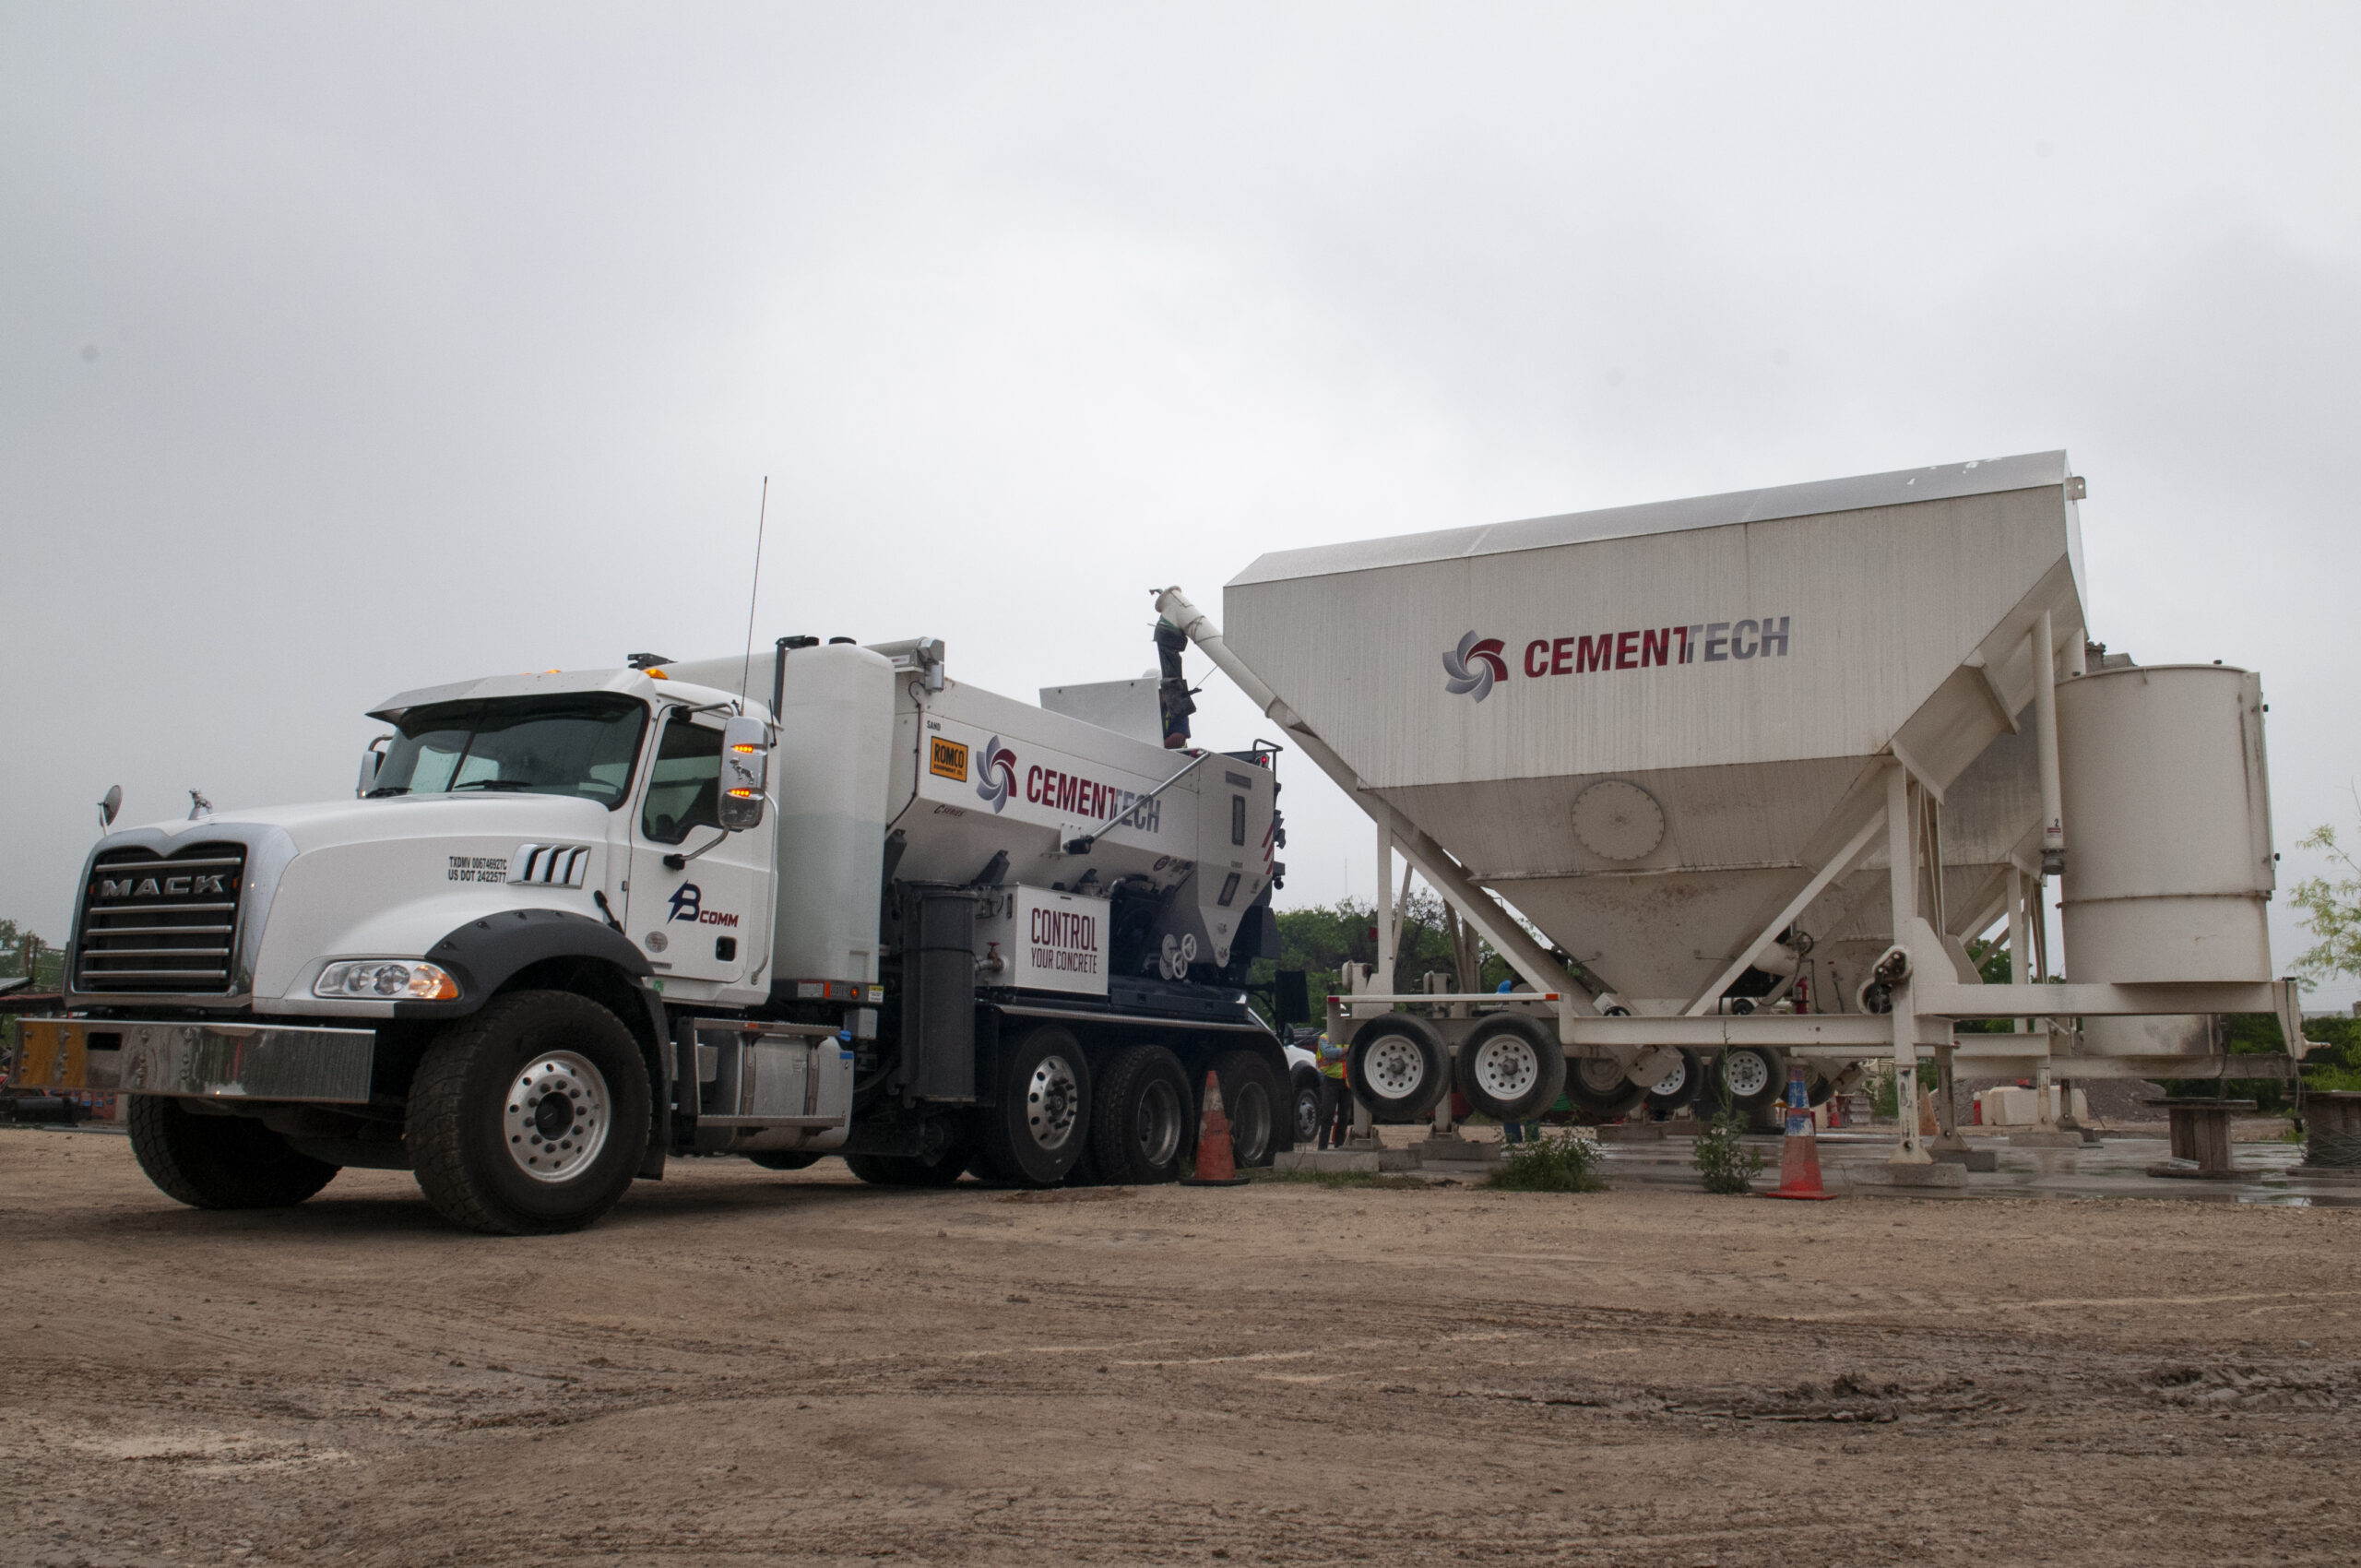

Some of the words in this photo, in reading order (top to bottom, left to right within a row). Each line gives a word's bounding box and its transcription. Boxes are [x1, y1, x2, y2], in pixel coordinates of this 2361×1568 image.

[1525, 615, 1790, 678] CEMENTECH
[927, 720, 941, 731] SAND
[934, 743, 965, 768] ROMCO
[1026, 765, 1161, 834] CEMENTECH
[449, 856, 471, 869] TXDMV
[101, 874, 225, 897] MACK
[448, 869, 458, 881] US
[460, 870, 475, 882] DOT
[477, 871, 506, 883] 2422577
[1031, 908, 1097, 952] CONTROL
[1031, 947, 1053, 969] YOUR
[1056, 950, 1097, 974] CONCRETE
